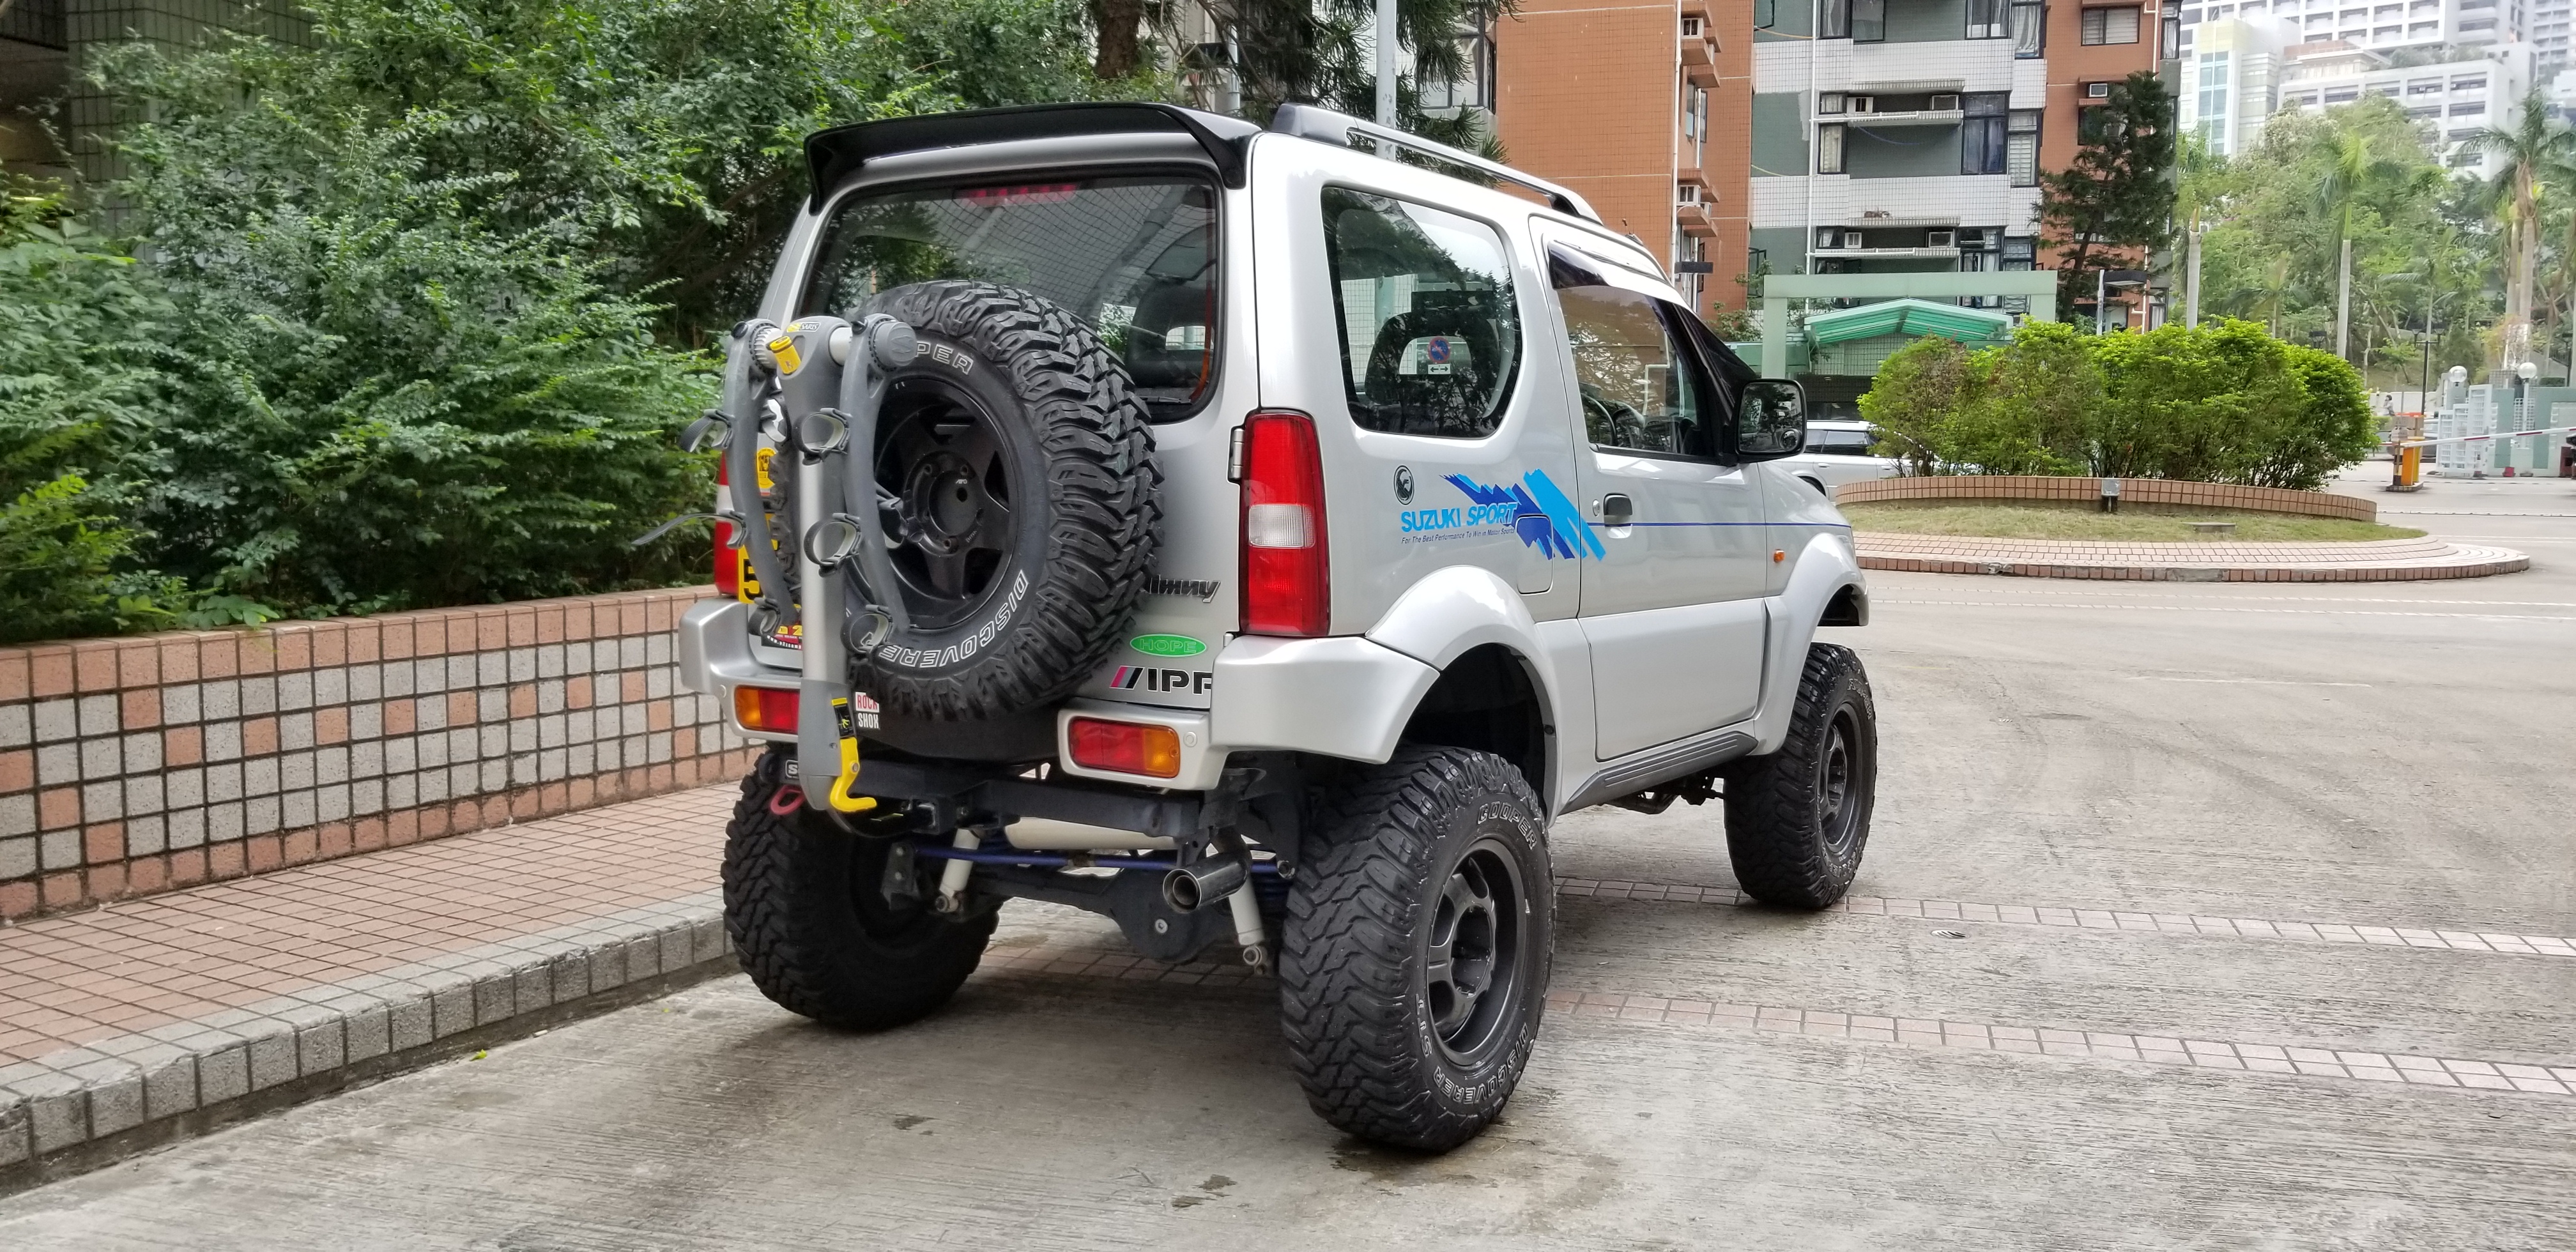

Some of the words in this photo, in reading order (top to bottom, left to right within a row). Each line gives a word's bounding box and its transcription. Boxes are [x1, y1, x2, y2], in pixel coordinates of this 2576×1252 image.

[800, 323, 819, 331] SARIS
[916, 340, 974, 375] PER
[1400, 507, 1462, 533] SUZUKI
[1466, 501, 1519, 526] SPORT
[1435, 532, 1466, 542] Performance
[1148, 574, 1220, 603] imny
[1139, 638, 1197, 653] HOPE
[857, 694, 878, 710] ROCK
[857, 712, 880, 729] SHOX
[1477, 800, 1537, 850] COOPER
[1432, 1022, 1529, 1104] DISCOVERER
